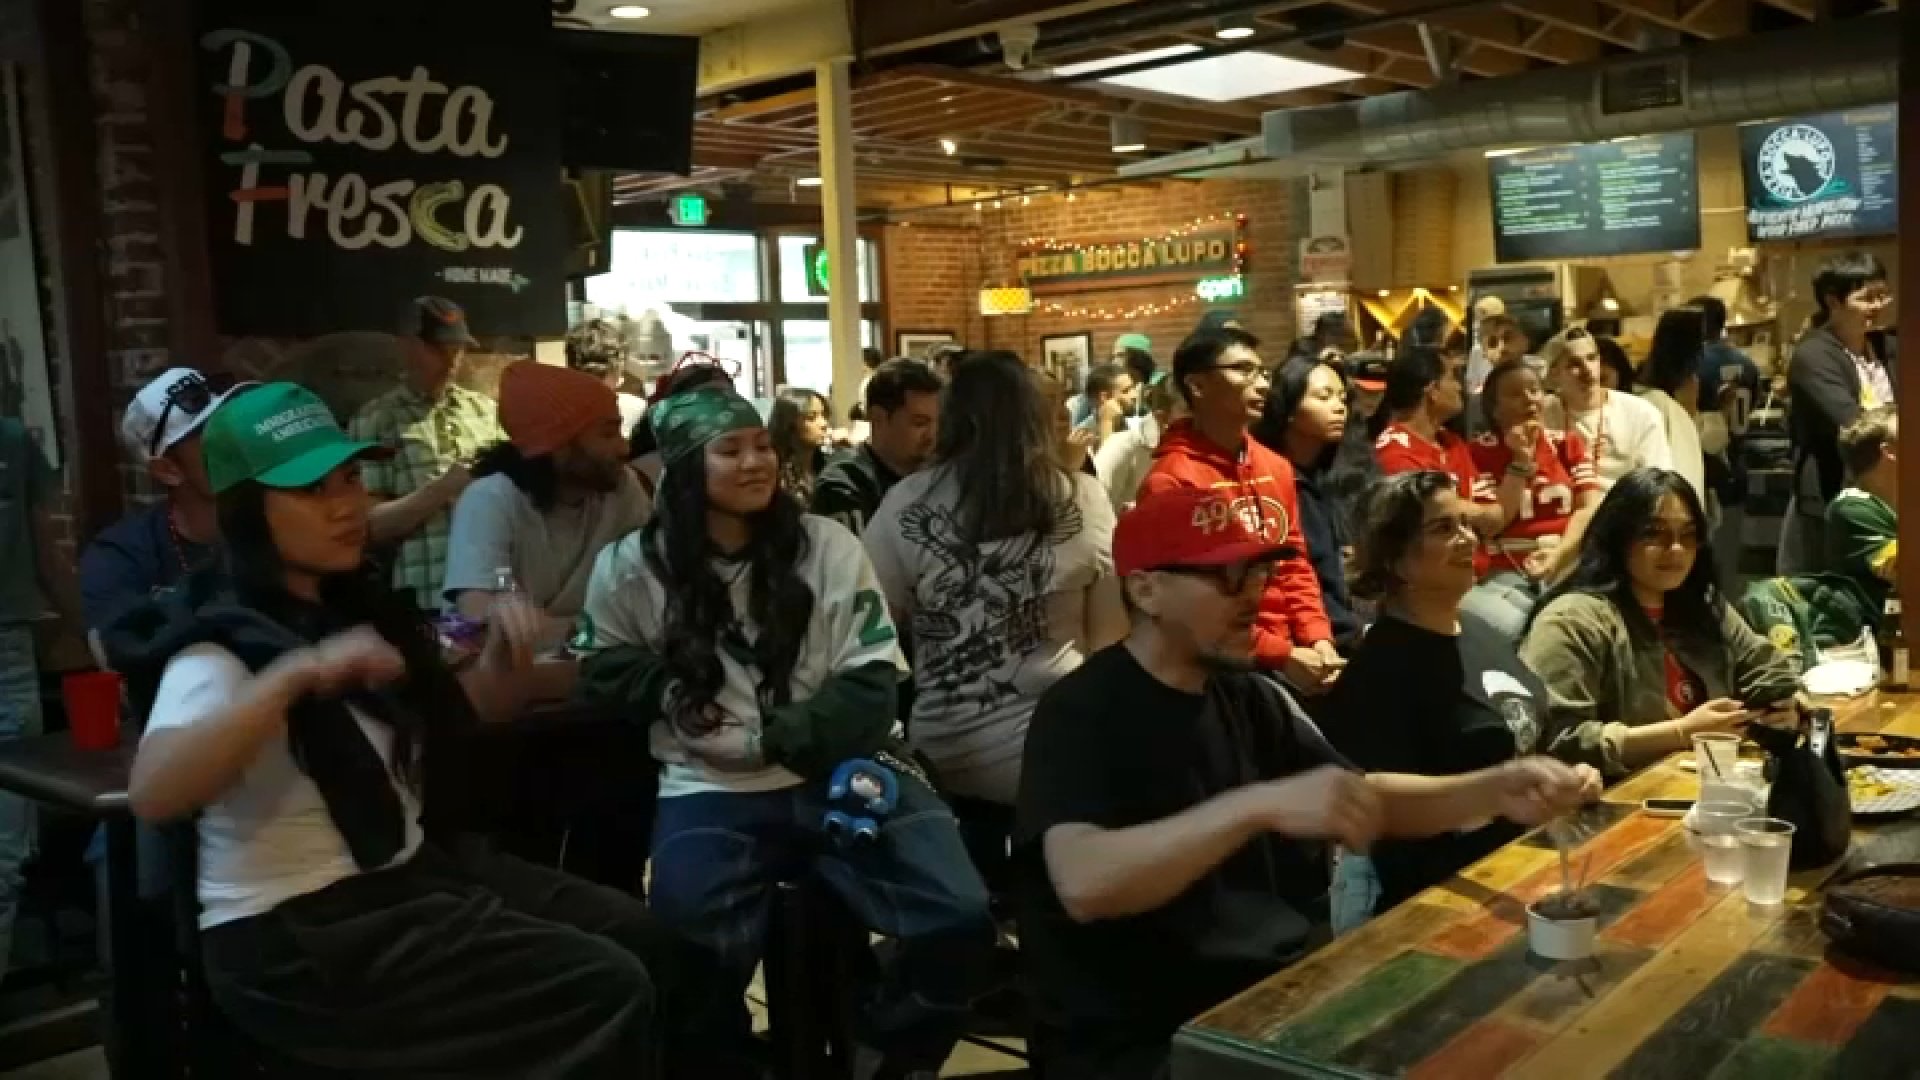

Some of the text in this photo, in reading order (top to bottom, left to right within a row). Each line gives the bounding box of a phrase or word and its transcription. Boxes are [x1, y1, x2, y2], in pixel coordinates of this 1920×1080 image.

[200, 28, 508, 158] Pasta
[221, 144, 524, 252] Fresca
[1081, 243, 1156, 273] BOCCA
[1162, 238, 1226, 265] LUPO
